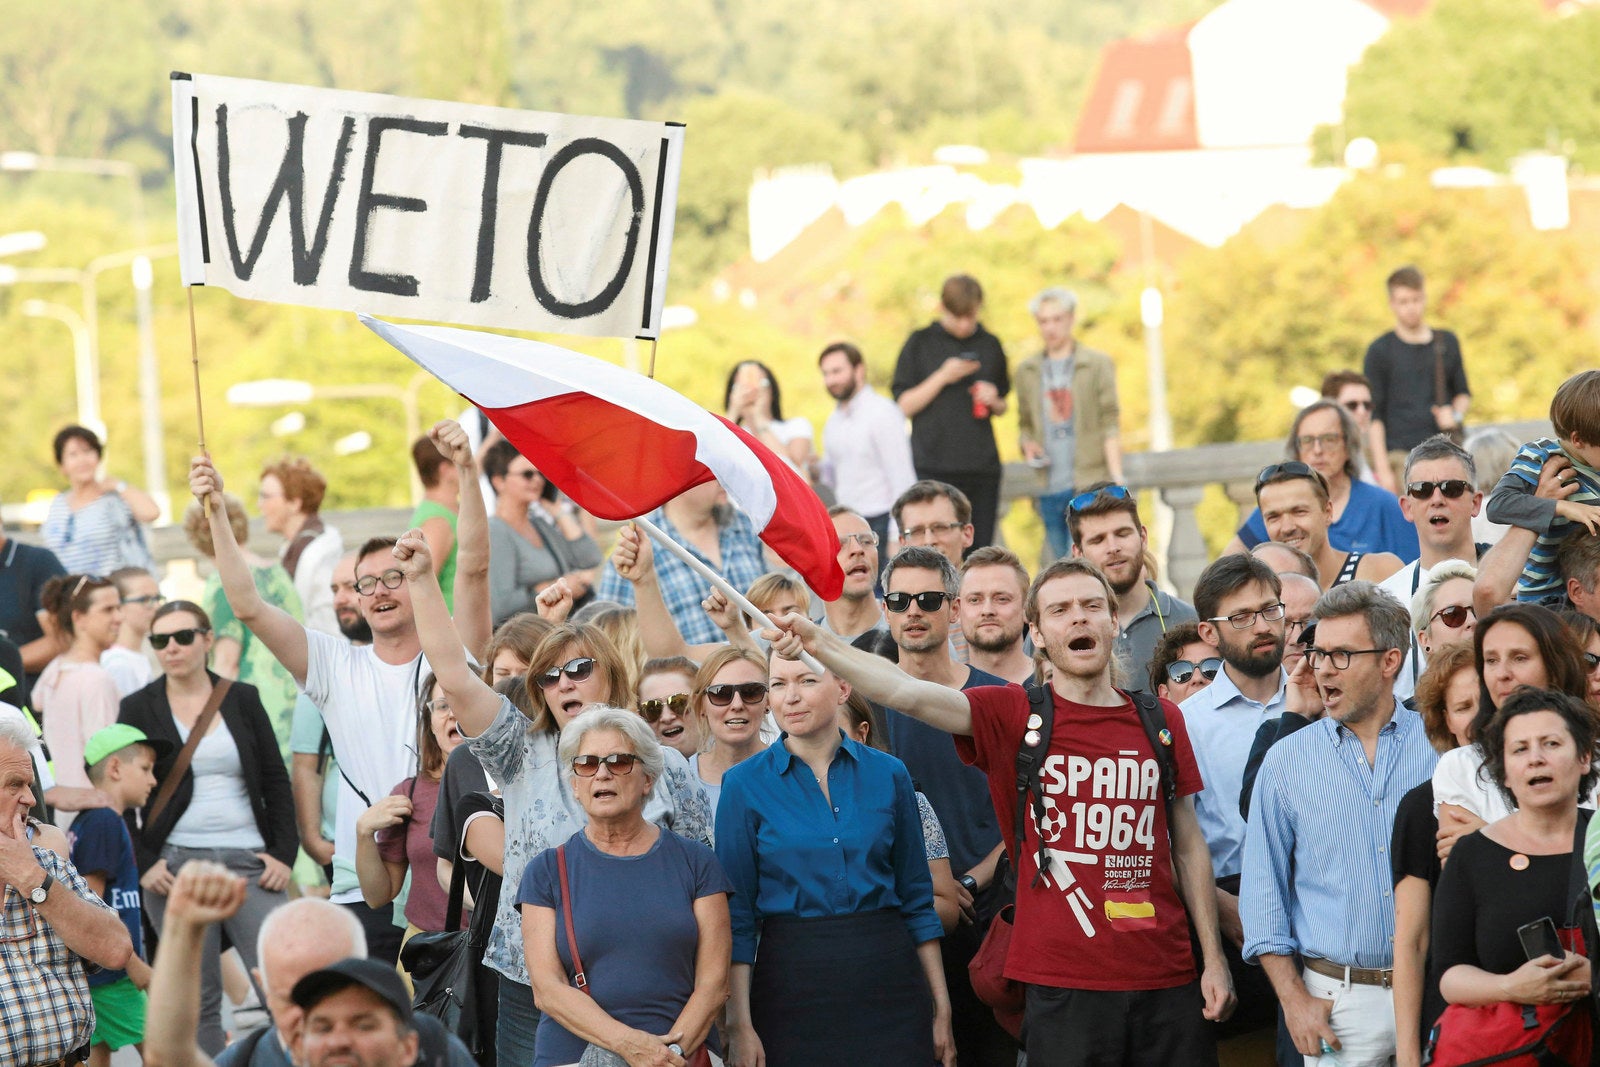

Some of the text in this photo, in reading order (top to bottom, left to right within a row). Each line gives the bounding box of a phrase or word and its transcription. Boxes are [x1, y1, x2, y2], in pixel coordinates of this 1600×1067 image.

[215, 103, 645, 319] WETO
[1071, 802, 1156, 851] 1964
[1104, 869, 1151, 878] SOCCER TEAM
[1116, 855, 1153, 868] HOUSE
